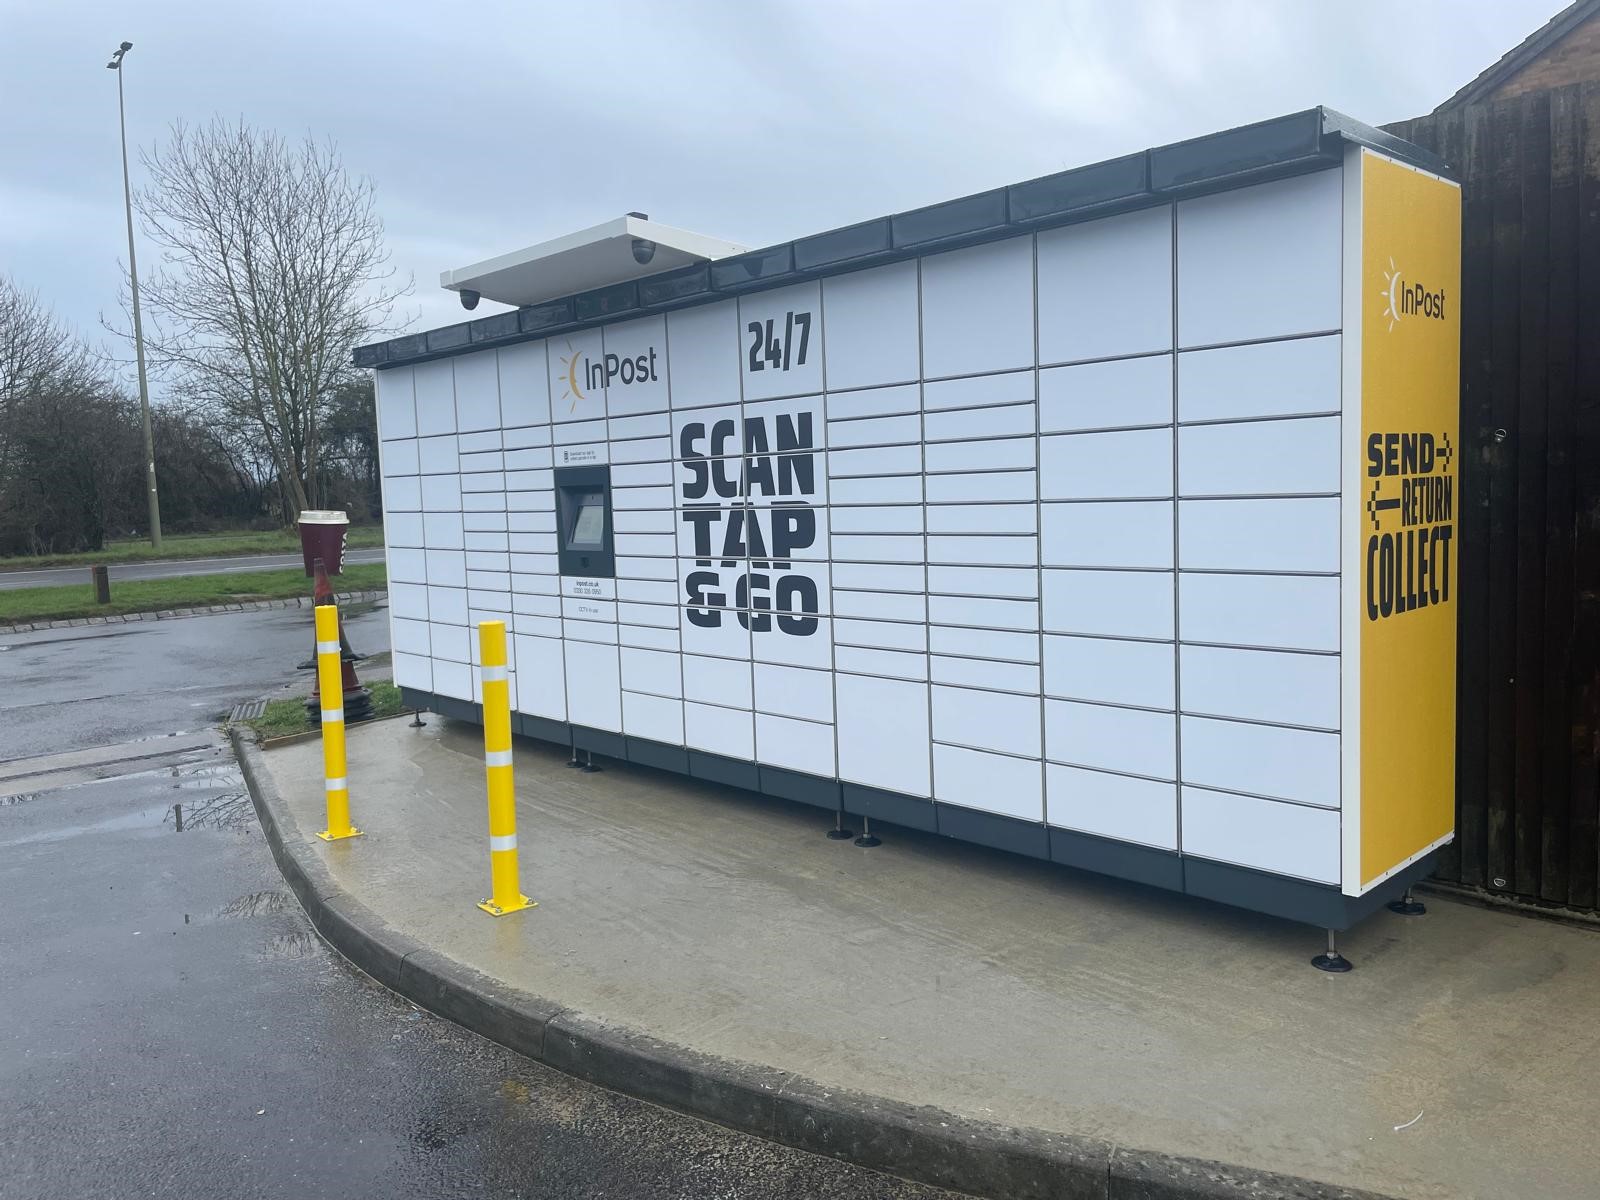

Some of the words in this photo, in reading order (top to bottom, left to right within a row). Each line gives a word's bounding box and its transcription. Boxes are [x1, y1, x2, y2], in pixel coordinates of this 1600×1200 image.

[1401, 281, 1445, 320] InPost
[585, 347, 657, 390] InPost
[748, 311, 811, 372] 24/7
[680, 412, 815, 499] SCAN
[1367, 432, 1434, 477] SEND
[1401, 475, 1453, 527] RETURN
[682, 500, 816, 570] TAP
[685, 571, 726, 628] &
[735, 573, 819, 636] GO
[1366, 525, 1452, 622] COLLECT
